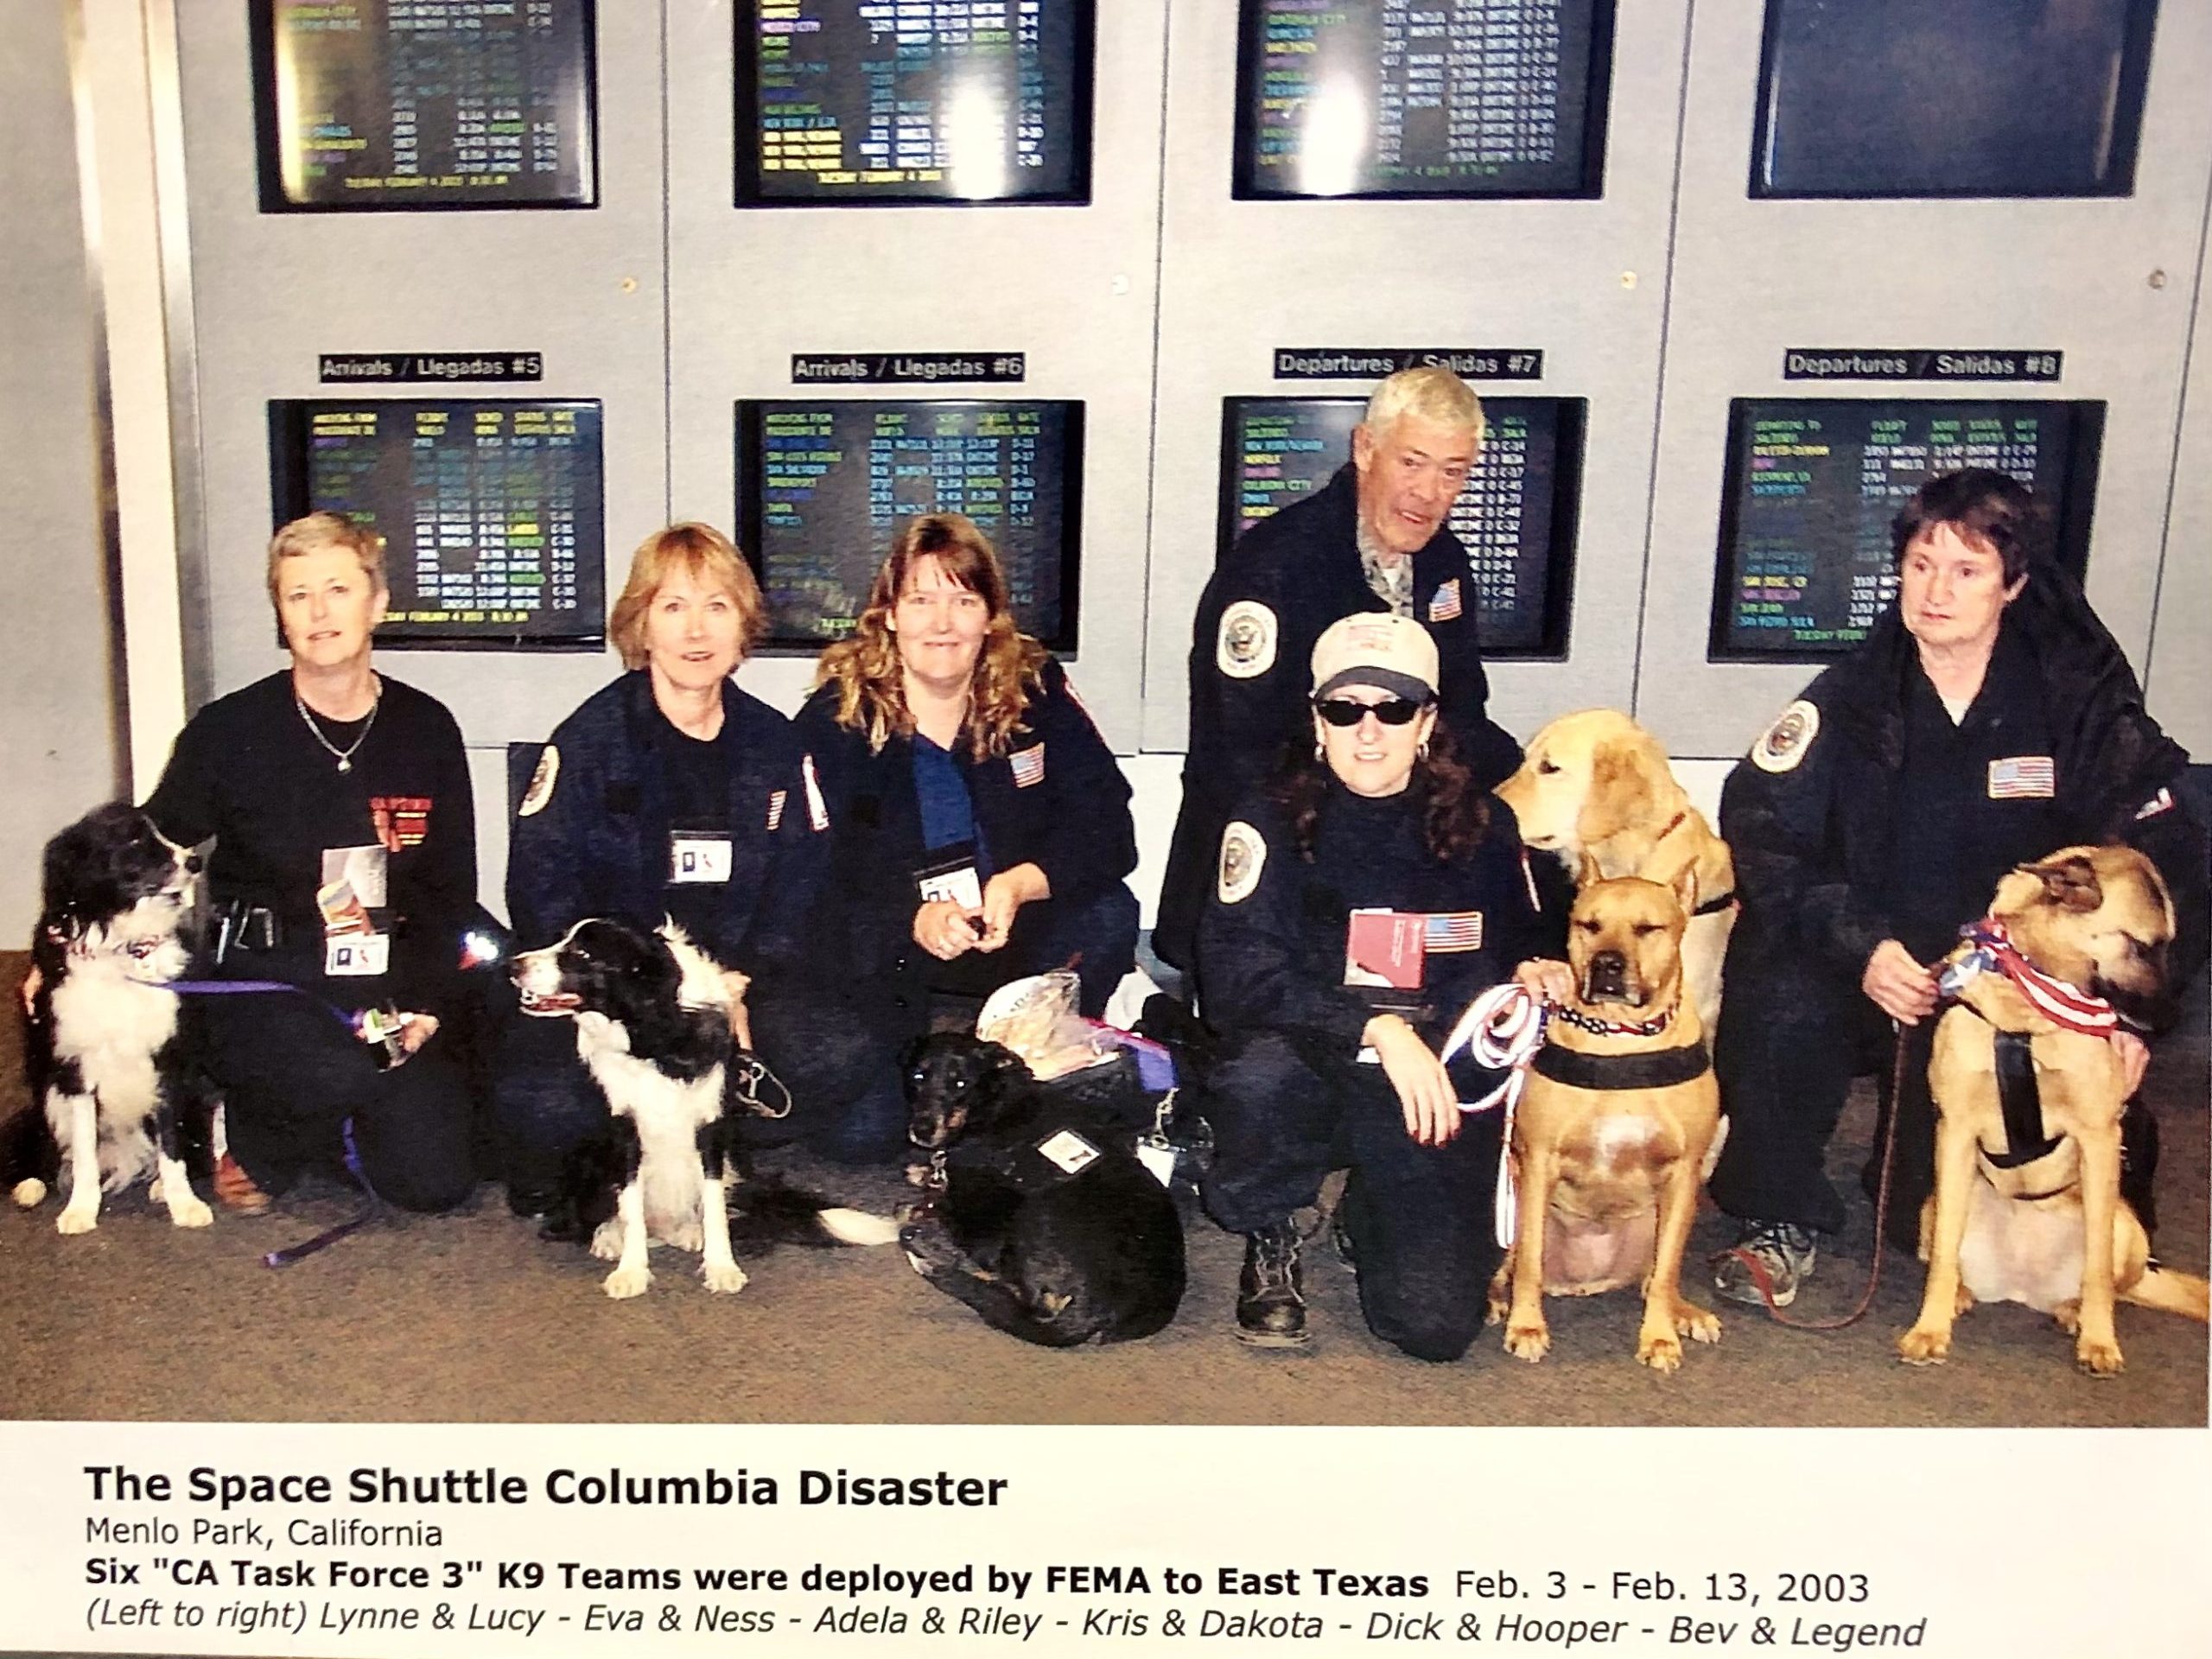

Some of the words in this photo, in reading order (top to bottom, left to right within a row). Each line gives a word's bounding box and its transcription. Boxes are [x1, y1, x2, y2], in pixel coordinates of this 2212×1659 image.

[322, 359, 393, 376] Arrivals
[416, 359, 505, 378] Llegadas
[512, 357, 541, 374] #5
[795, 359, 869, 377] Arrivals
[894, 359, 986, 379] Llegadas
[993, 357, 1024, 375] #6
[1278, 354, 1395, 375] Departures
[1506, 355, 1536, 373] #7
[1788, 354, 1909, 376] Departures
[1936, 354, 2015, 374] Salidas
[2024, 355, 2056, 375] #8
[83, 1465, 171, 1502] The
[188, 1466, 331, 1511] Space
[349, 1467, 528, 1504] Shuttle
[545, 1467, 778, 1506] Columbia
[799, 1468, 1008, 1507] Disaster
[86, 1516, 179, 1545] Menlo
[194, 1517, 273, 1551] Park,
[288, 1518, 442, 1547] California
[86, 1557, 140, 1585] Six
[154, 1557, 219, 1586] "CA
[231, 1560, 315, 1587] Task
[329, 1560, 429, 1588] Force
[442, 1560, 482, 1589] 3"
[499, 1561, 544, 1590] K9
[557, 1562, 681, 1591] Teams
[693, 1569, 788, 1591] were
[801, 1563, 973, 1599] deployed
[988, 1564, 1033, 1600] by
[1047, 1566, 1152, 1594] FEMA
[1163, 1567, 1203, 1595] to
[1218, 1567, 1300, 1596] East
[1313, 1568, 1429, 1598] Texas
[1457, 1569, 1529, 1599] Feb.
[1547, 1571, 1566, 1599] 3
[1613, 1571, 1686, 1600] Feb.
[1706, 1573, 1759, 1607] 13,
[1777, 1573, 1869, 1603] 2003
[87, 1598, 163, 1631] (Left
[174, 1601, 204, 1627] to
[217, 1600, 307, 1635] right)
[320, 1602, 419, 1635] Lynne
[432, 1602, 455, 1630] &
[468, 1603, 545, 1637] Lucy
[584, 1604, 644, 1631] Eva
[658, 1604, 681, 1632] &
[695, 1605, 776, 1633] Ness
[813, 1605, 908, 1634] Adela
[922, 1606, 945, 1634] &
[958, 1606, 1043, 1642] Riley
[1083, 1608, 1149, 1637] Kris
[1162, 1608, 1186, 1637] &
[1199, 1609, 1324, 1639] Dakota
[1366, 1611, 1444, 1640] Dick
[1457, 1612, 1481, 1641] &
[1496, 1613, 1629, 1649] Hooper
[1669, 1616, 1738, 1644] Bev
[1751, 1617, 1776, 1645] &
[1791, 1617, 1928, 1653] Legend
